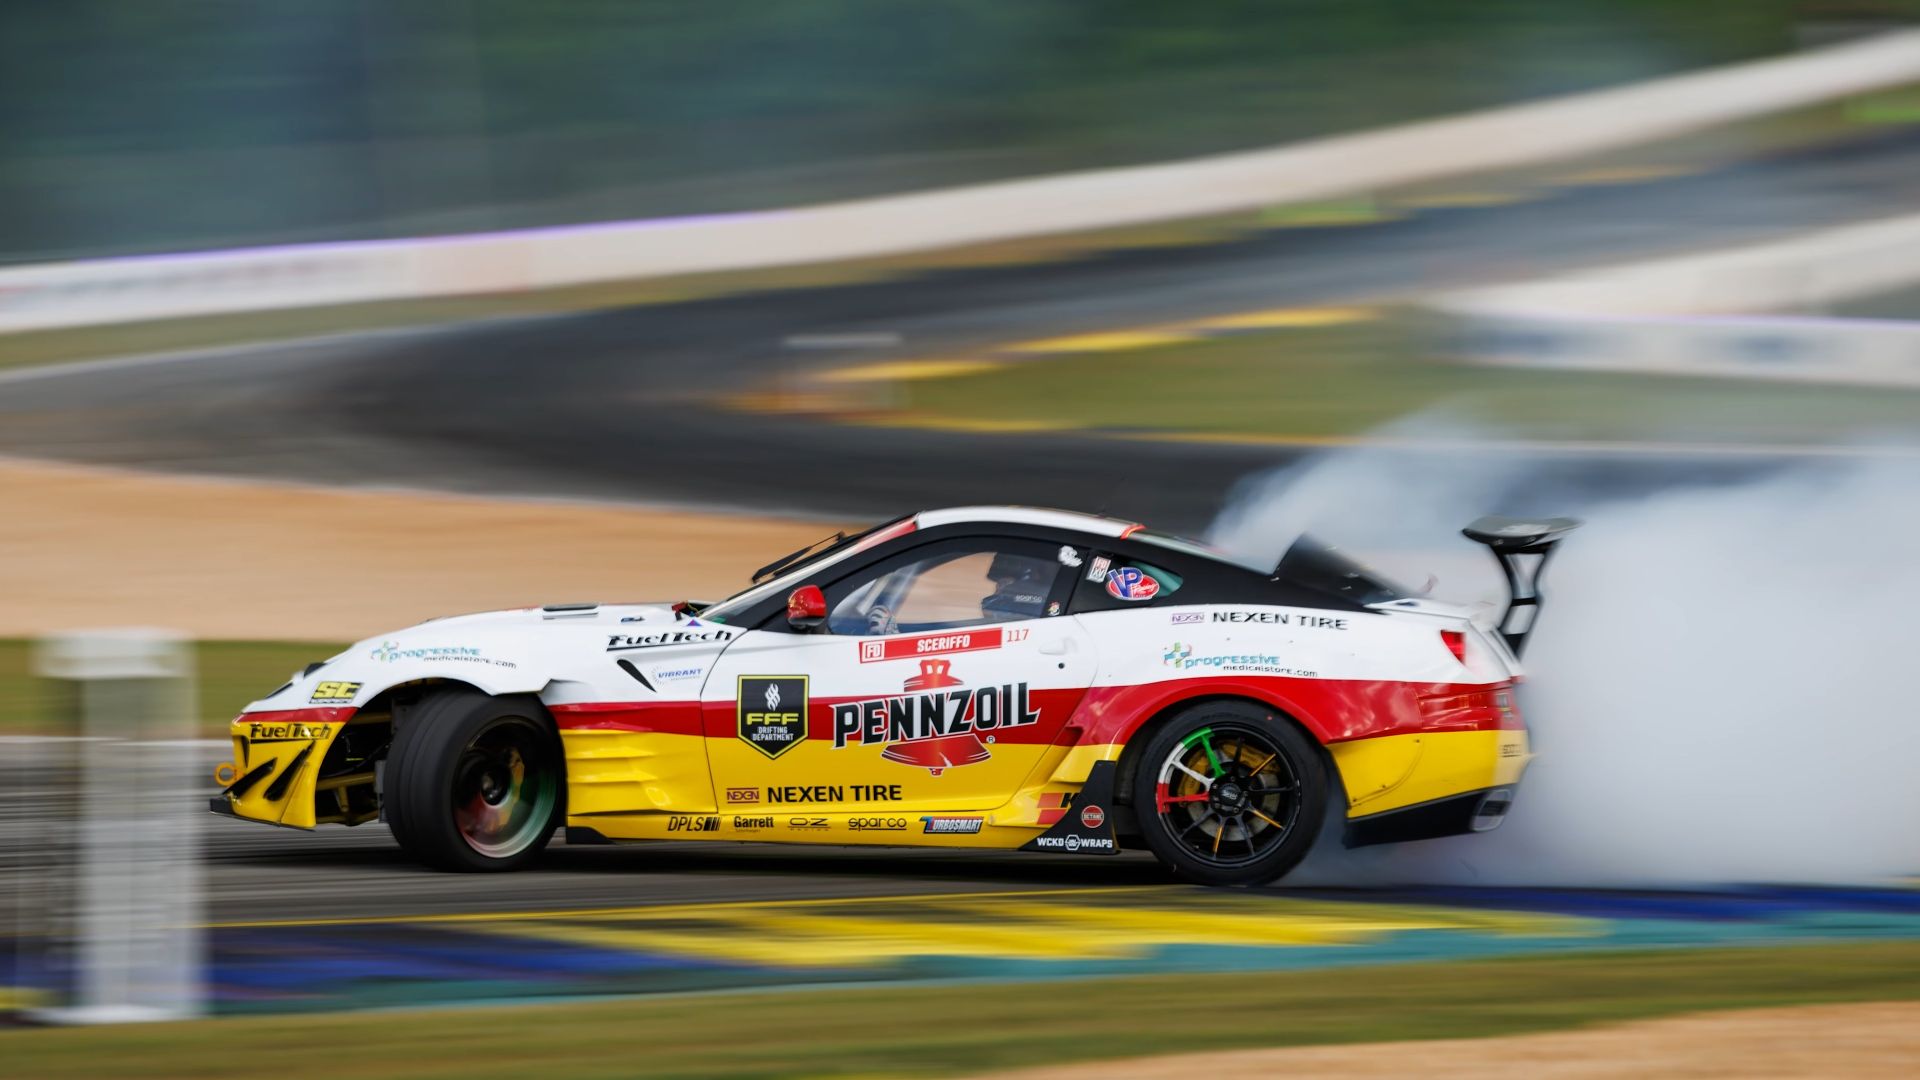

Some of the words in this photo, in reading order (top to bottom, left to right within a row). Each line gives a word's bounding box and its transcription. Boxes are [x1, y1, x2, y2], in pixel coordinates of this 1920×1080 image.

[1213, 612, 1289, 625] NEXEN
[1296, 615, 1349, 630] TIRE
[608, 630, 732, 648] FuelTech
[916, 635, 971, 653] SCERIFFO
[1007, 629, 1030, 642] 117
[389, 647, 480, 663] progressive
[1185, 654, 1280, 669] progressive
[658, 669, 703, 678] VIBRANT
[1223, 665, 1318, 678] medicalstore.com
[747, 713, 798, 725] FFF
[829, 682, 1041, 749] PENNZOIL
[250, 723, 332, 739] FuelTech
[752, 733, 794, 741] DEPARTMENT
[758, 726, 788, 734] DRIFTING
[767, 786, 844, 803] NEXEN
[850, 785, 902, 801] TIRE
[667, 816, 704, 831] DPLS
[734, 816, 774, 828] Garrett
[848, 817, 907, 831] sparco
[1037, 838, 1064, 847] WCKD
[1081, 838, 1113, 848] WRAPS
